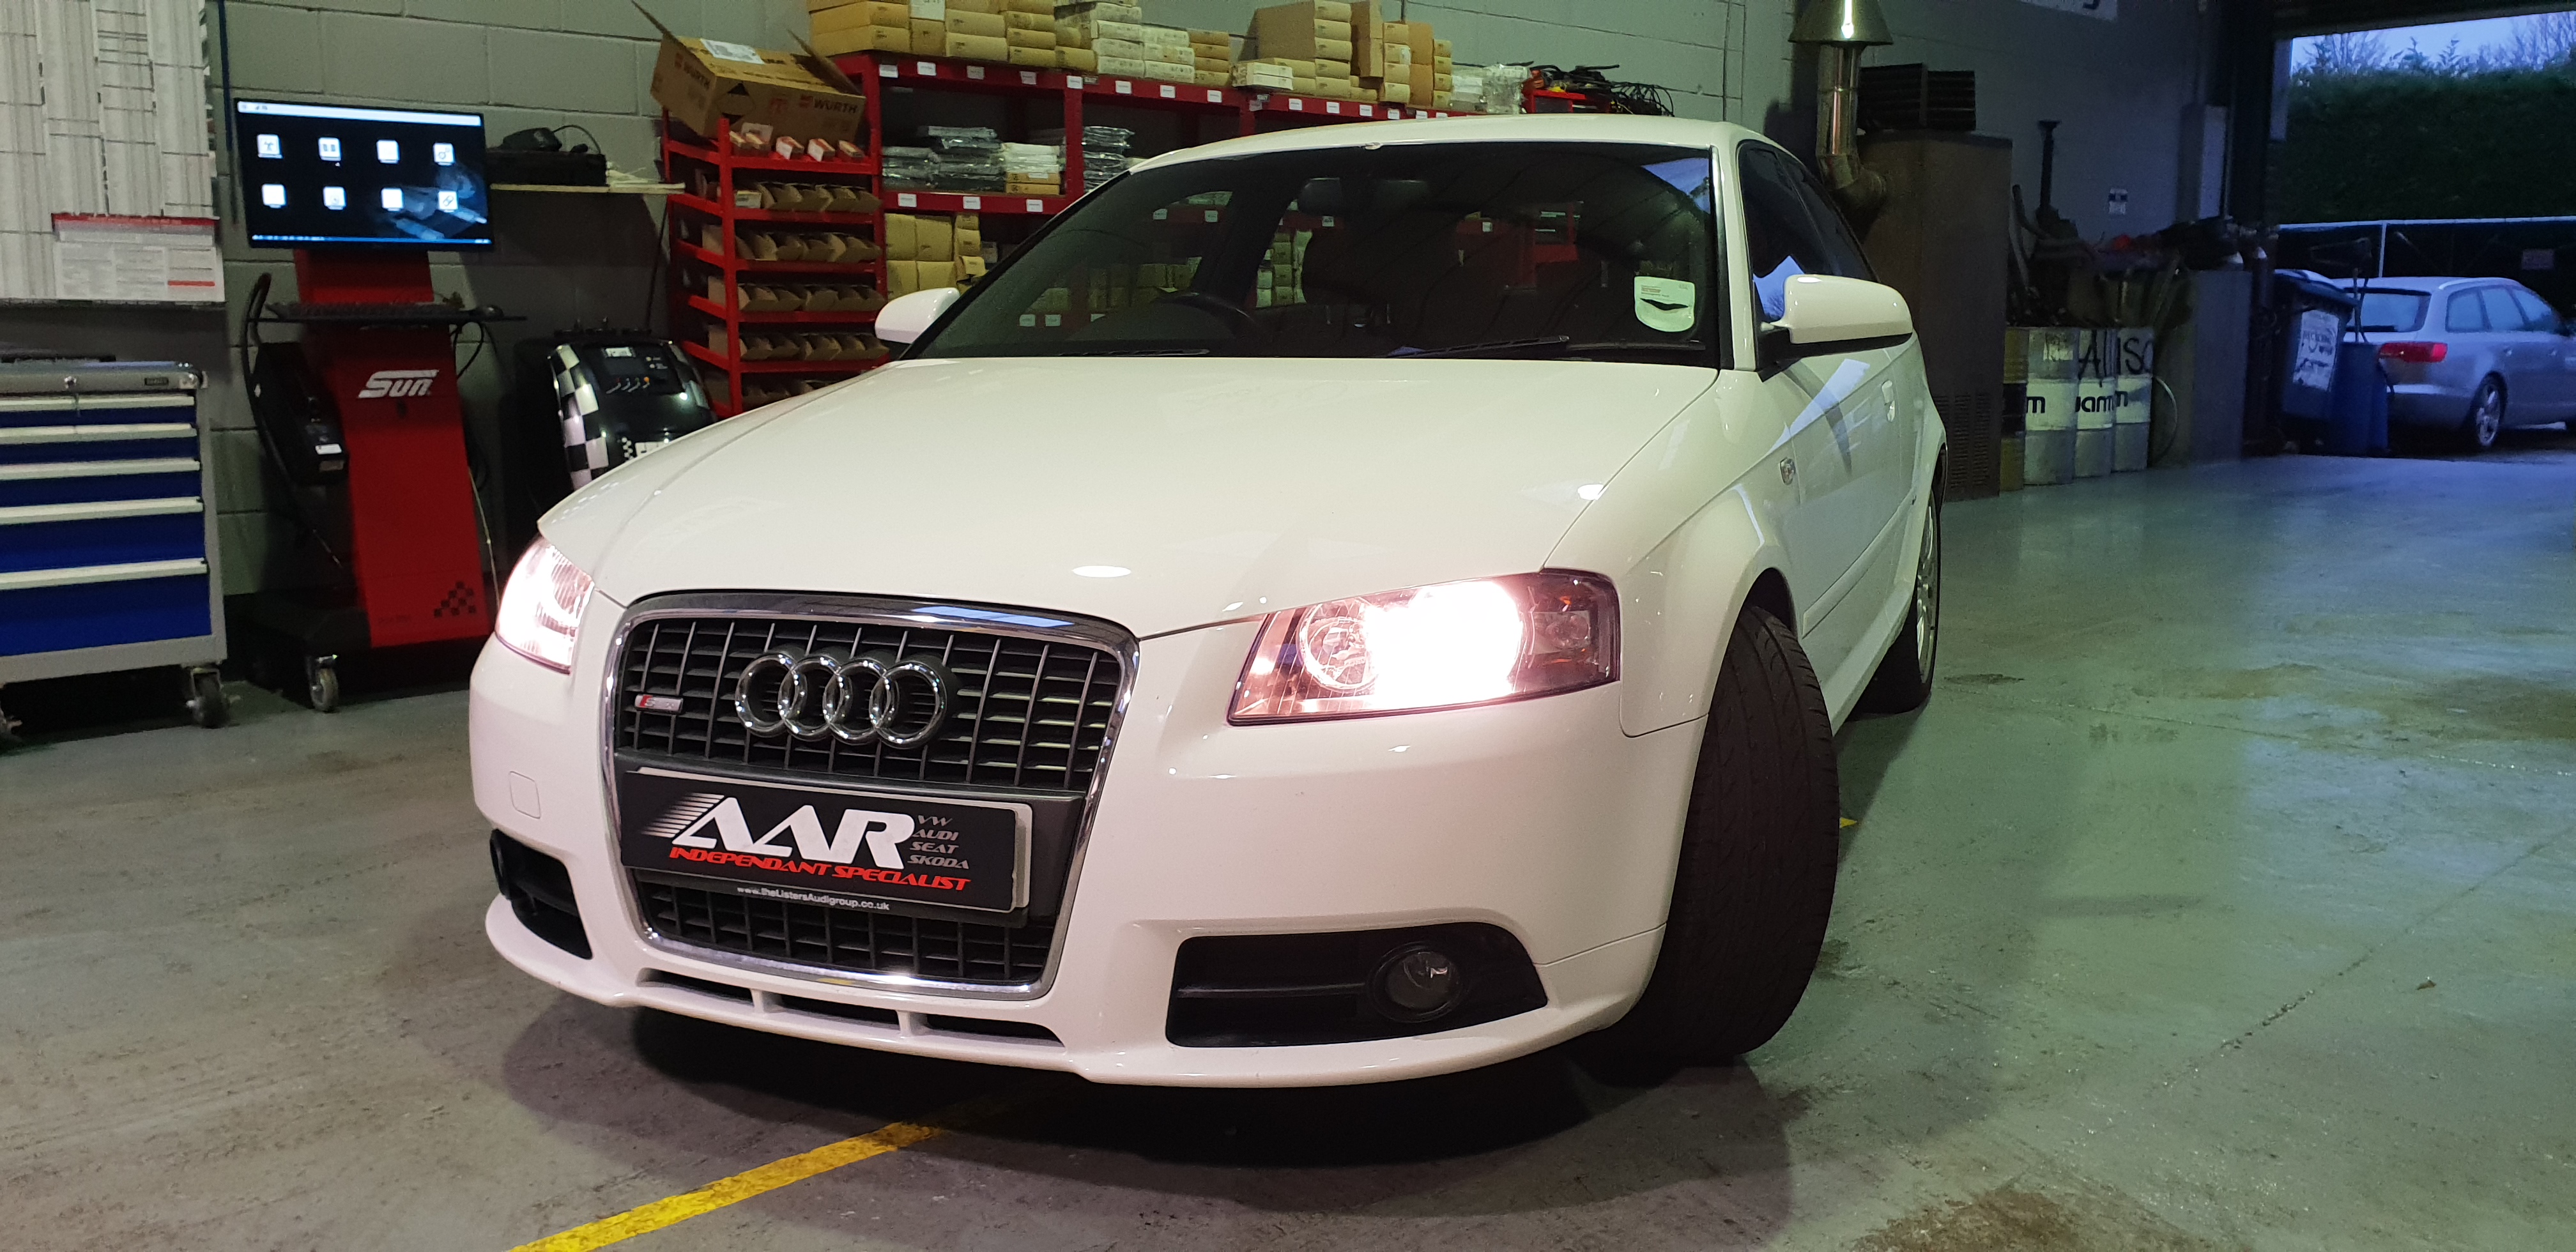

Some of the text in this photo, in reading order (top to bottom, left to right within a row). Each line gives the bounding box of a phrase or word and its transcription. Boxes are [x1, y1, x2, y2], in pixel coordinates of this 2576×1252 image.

[917, 814, 953, 827] VW
[671, 797, 915, 869] AAR
[912, 828, 959, 841] AUDI
[909, 841, 959, 854] SEAT
[669, 846, 972, 890] INDEPENDANT SPECIALIST
[907, 854, 969, 869] SKODA
